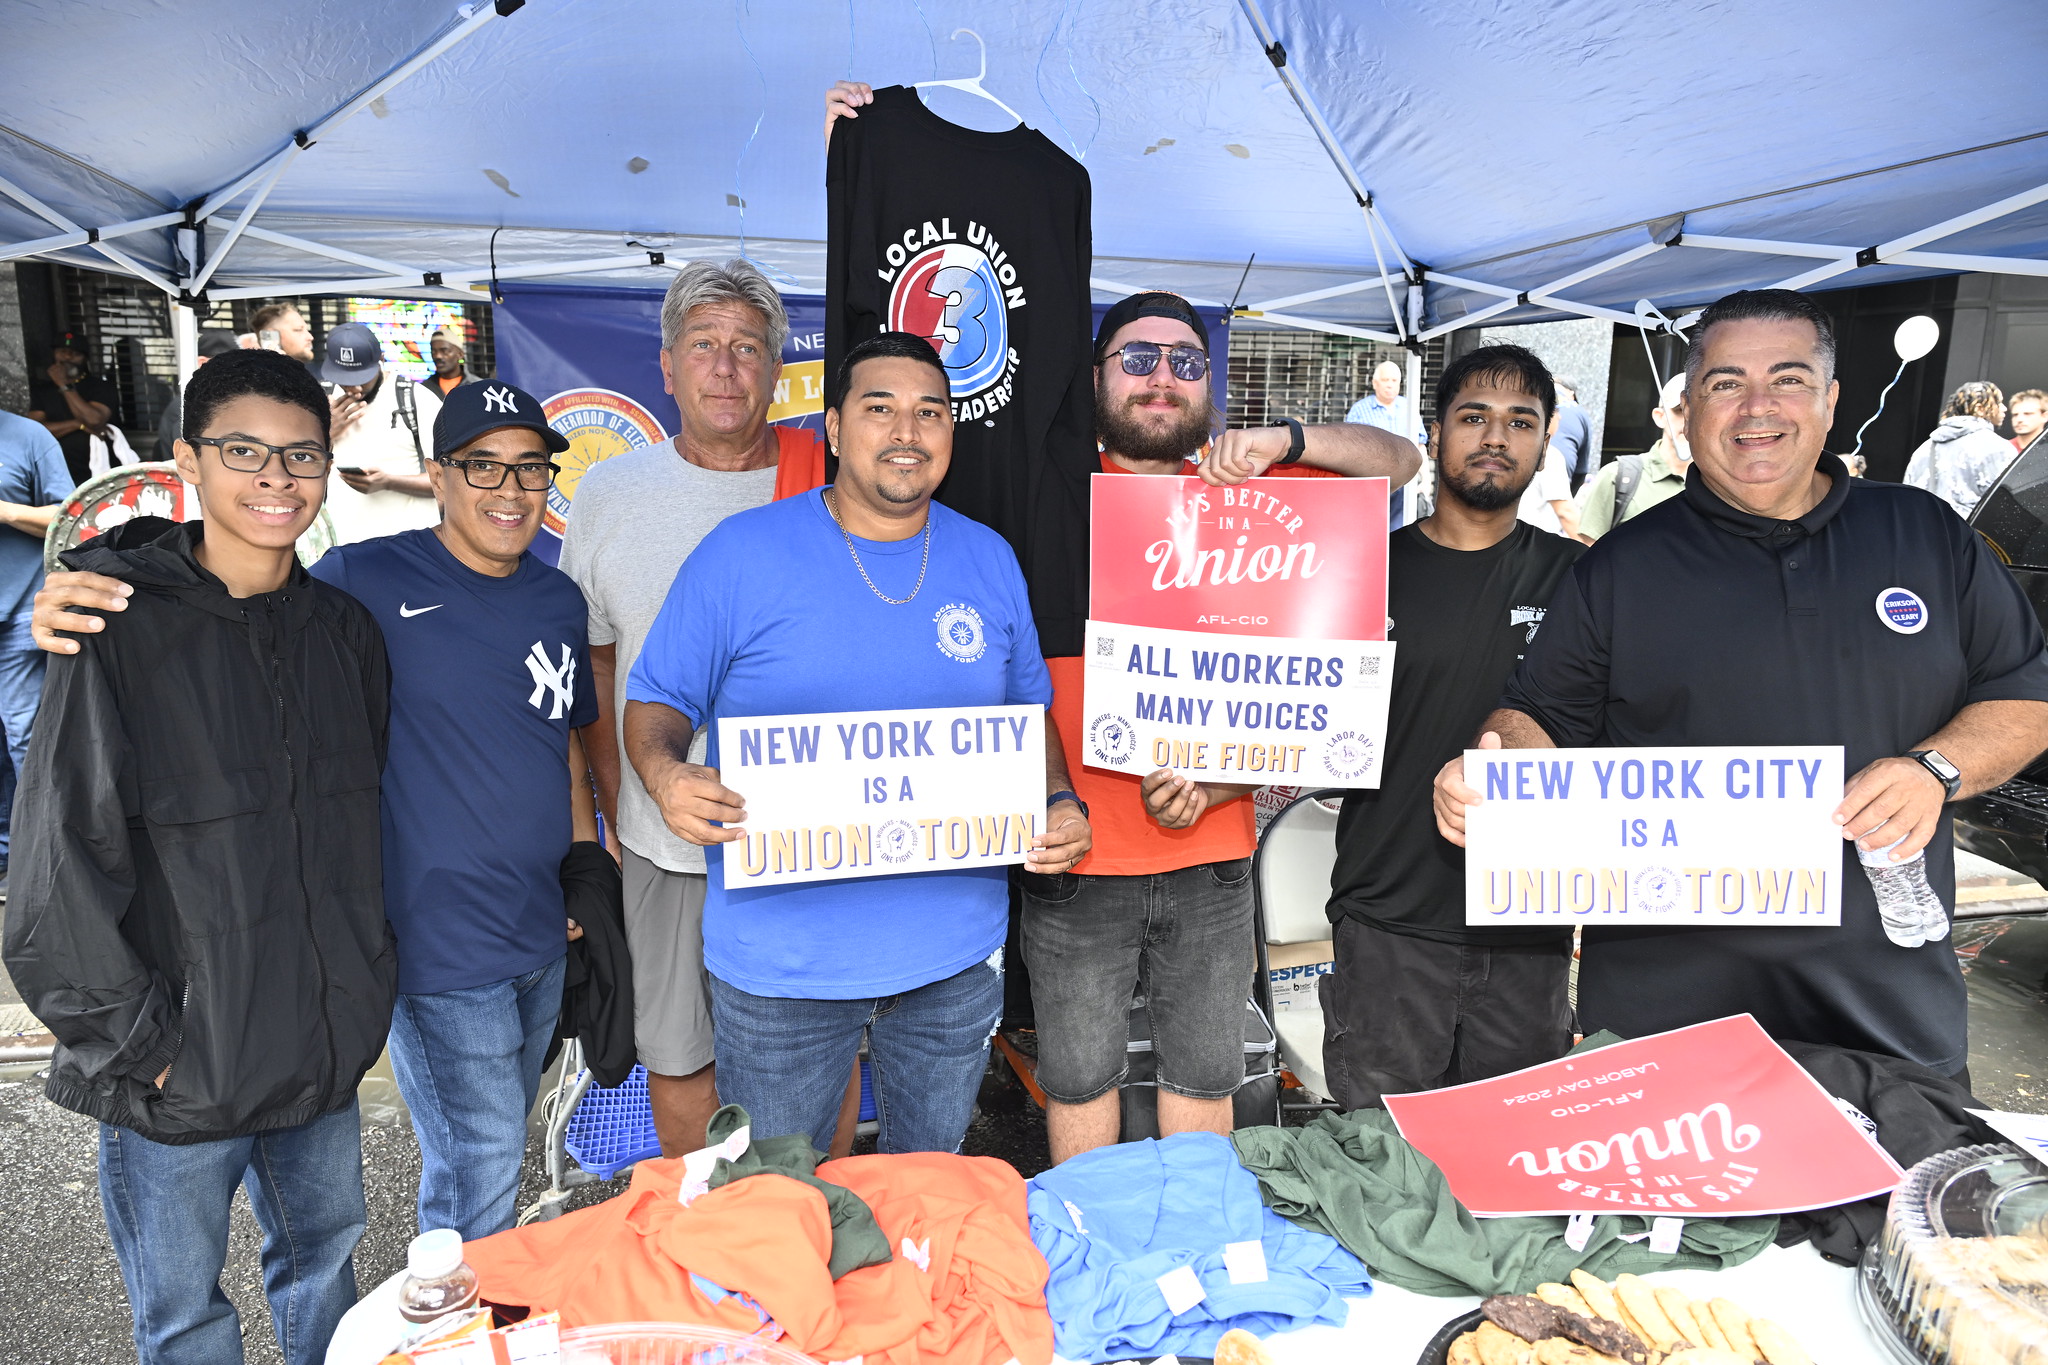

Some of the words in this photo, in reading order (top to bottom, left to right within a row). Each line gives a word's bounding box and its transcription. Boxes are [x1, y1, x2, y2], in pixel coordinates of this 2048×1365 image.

[878, 217, 957, 283] LOCAL
[967, 220, 1027, 310] UNION
[918, 265, 988, 370] 3
[482, 385, 519, 414] NY
[563, 395, 600, 406] AFFILIATED
[601, 396, 619, 407] WITH
[608, 415, 625, 431] OF
[1165, 492, 1211, 529] IT'S
[1223, 487, 1304, 535] BETTER
[1218, 517, 1234, 530] IN
[1242, 517, 1251, 530] A
[1144, 535, 1325, 591] Union
[932, 603, 957, 623] LOCAL
[1884, 599, 1917, 608] ERIKSON
[1892, 613, 1919, 621] CLEARY
[1196, 614, 1269, 625] AFL-CIO
[936, 641, 953, 658] NEW
[976, 641, 988, 659] CITY
[524, 640, 576, 720] NY
[1127, 643, 1178, 678] ALL
[1192, 650, 1344, 688] WORKERS
[1091, 713, 1111, 731] WORKERS
[1117, 716, 1131, 729] MANY
[1136, 692, 1214, 726] MANY
[1226, 700, 1328, 731] VOICES
[739, 725, 821, 767] NEW
[837, 720, 935, 761] YORK
[951, 716, 1029, 756] CITY
[1326, 731, 1355, 748] LABOR
[1357, 734, 1374, 748] DAY
[1095, 749, 1109, 763] ONE
[1111, 753, 1131, 765] FIGHT
[1152, 737, 1208, 769] ONE
[1219, 743, 1306, 772] FIGHT
[1323, 756, 1342, 778] PARADE
[1353, 757, 1374, 778] MARCH
[864, 777, 888, 804] IS
[899, 775, 914, 802] A
[1486, 761, 1574, 801] NEW
[1592, 759, 1704, 800] YORK
[1726, 758, 1822, 800] CITY
[739, 823, 872, 877] UNION
[917, 813, 1035, 861] TOWN
[1621, 818, 1648, 847] IS
[1661, 819, 1679, 847] A
[881, 853, 893, 863] ONE
[896, 850, 913, 864] FIGHT
[1483, 868, 1628, 915] UNION
[1683, 867, 1826, 915] TOWN
[1556, 1078, 1592, 1096] DAY
[1593, 1061, 1660, 1085] LABOR
[1503, 1089, 1552, 1106] 2024
[1550, 1089, 1644, 1118] AFL-CIO
[1507, 1102, 1761, 1177] Union
[1557, 1178, 1699, 1208] BETTER
[1629, 1177, 1645, 1188] A
[1654, 1174, 1682, 1187] IN
[1702, 1161, 1759, 1202] IT'S
